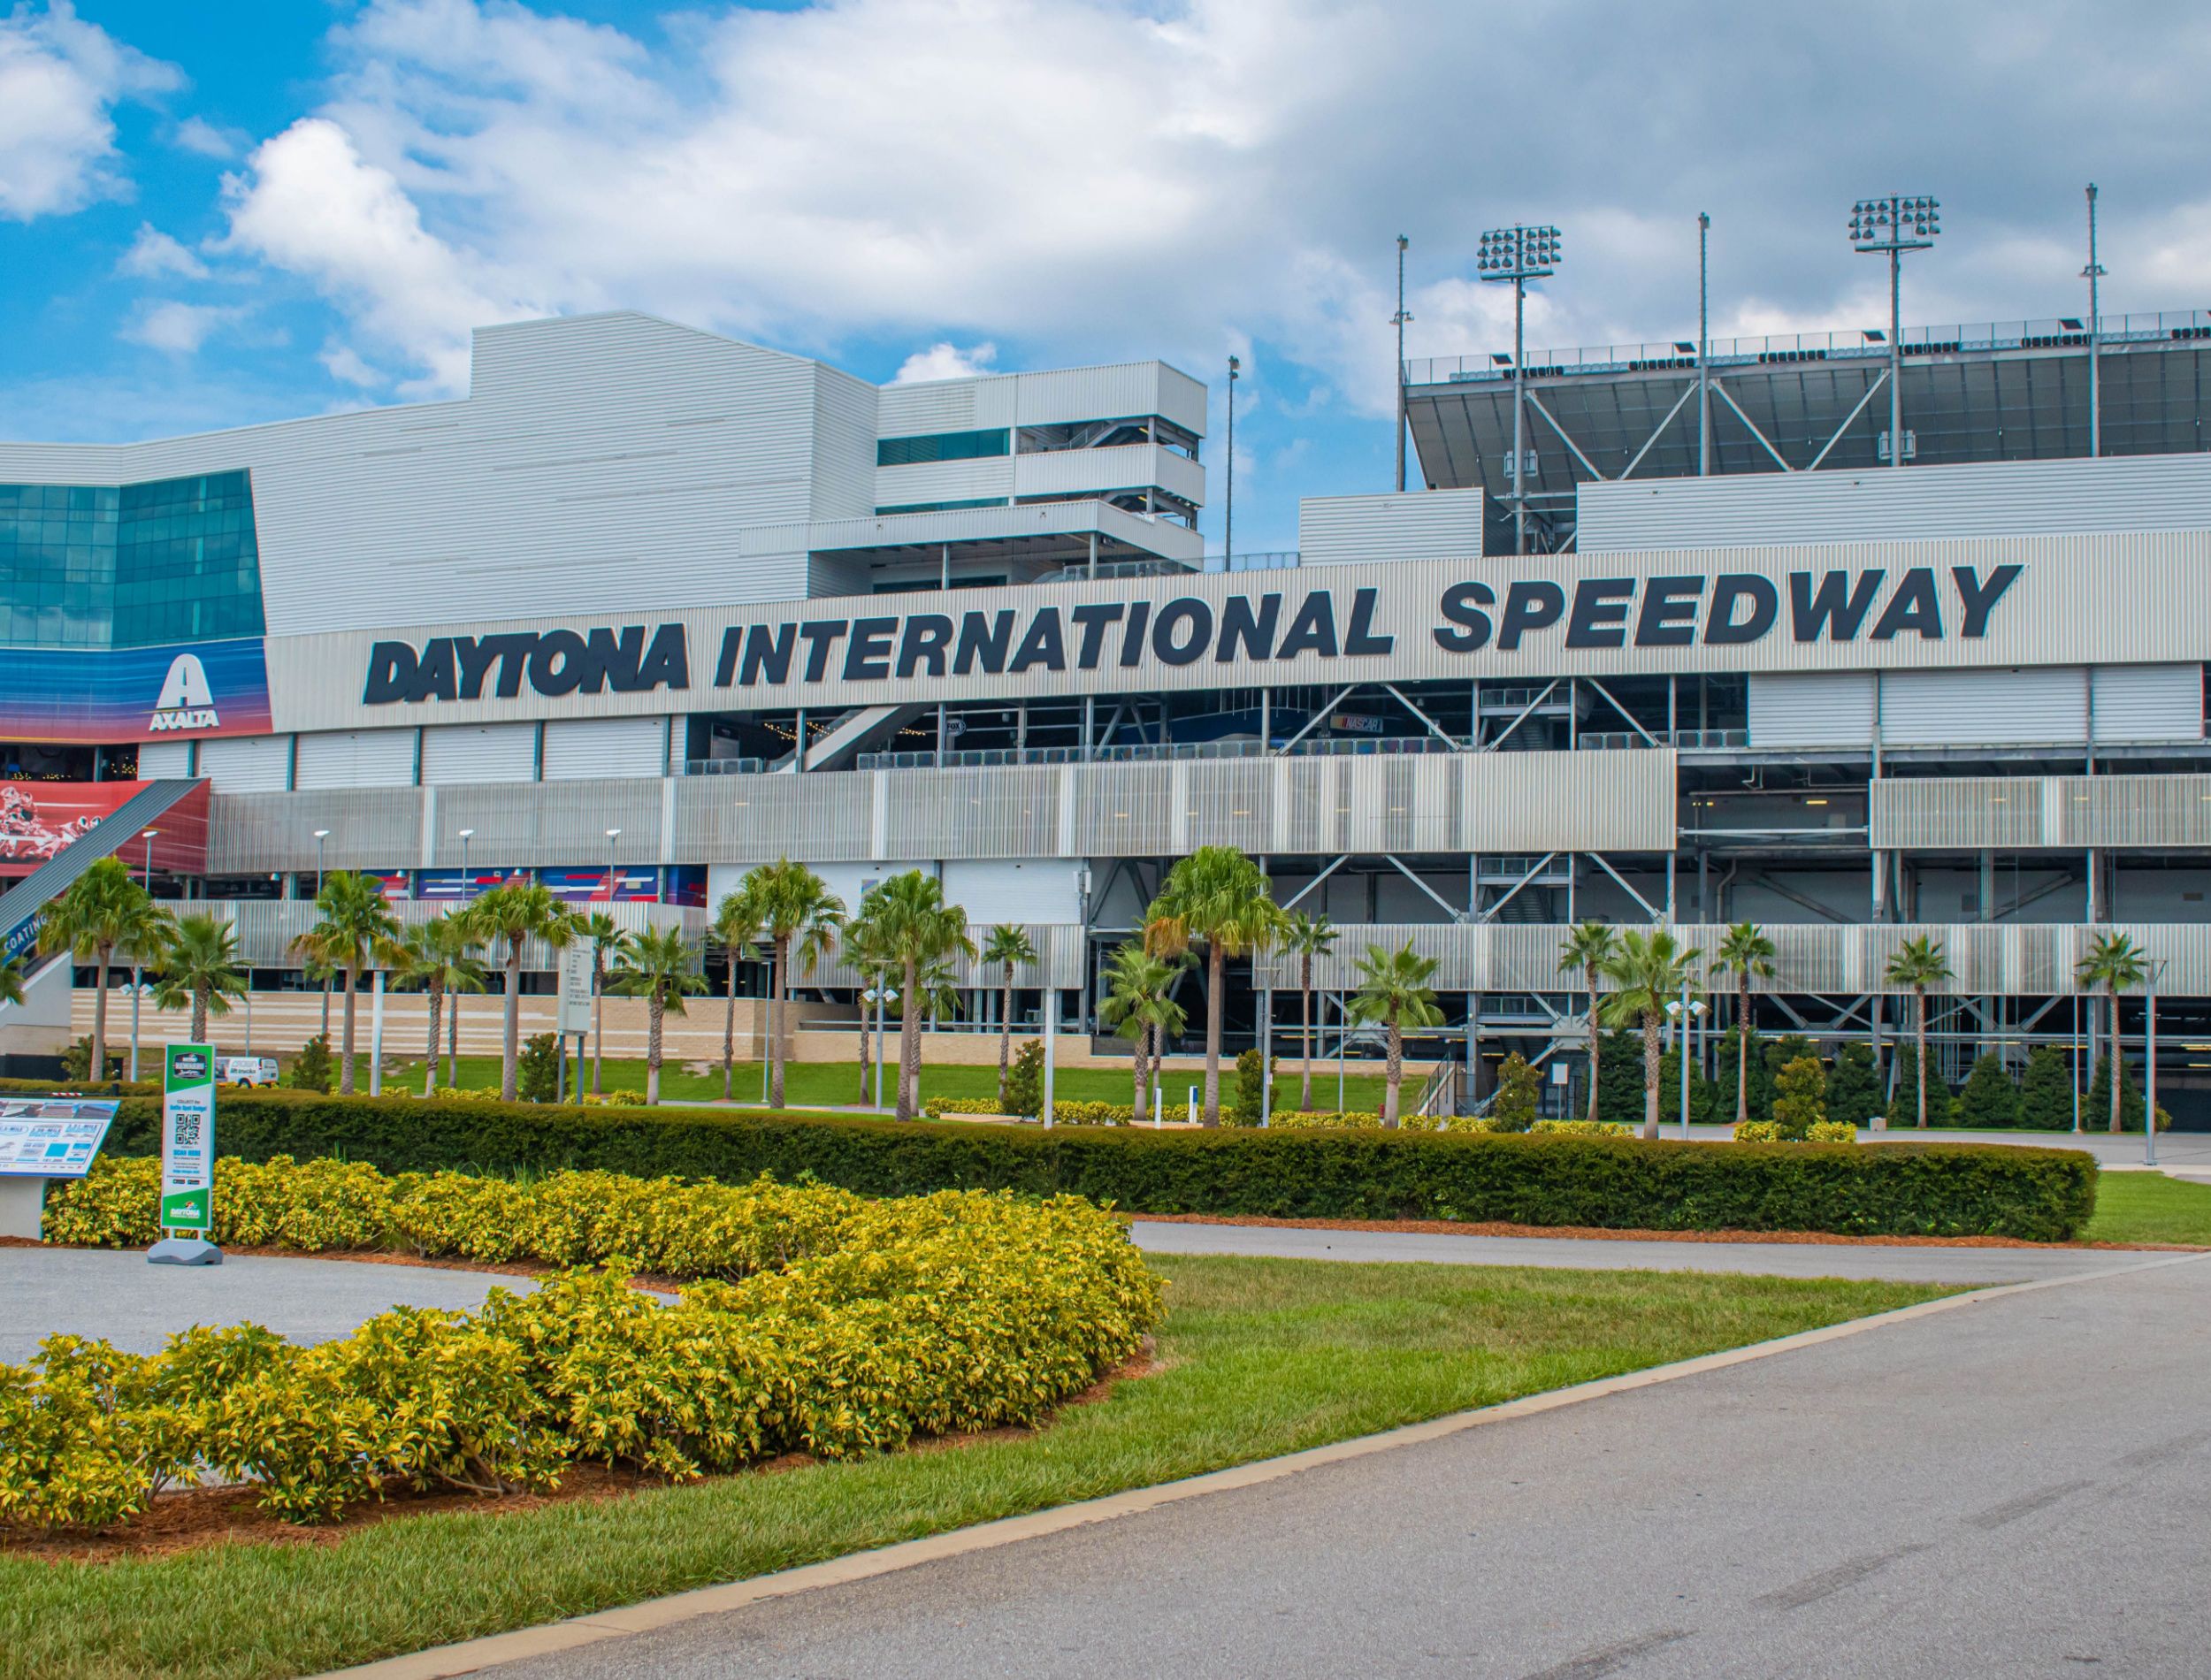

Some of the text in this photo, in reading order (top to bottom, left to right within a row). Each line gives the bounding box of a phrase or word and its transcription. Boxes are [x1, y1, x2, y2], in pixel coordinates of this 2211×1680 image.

[363, 564, 2024, 705] DAYTONA INTERNATIONAL SPEEDWAY
[149, 710, 219, 731] AXALTA
[1345, 715, 1380, 731] NASCAR
